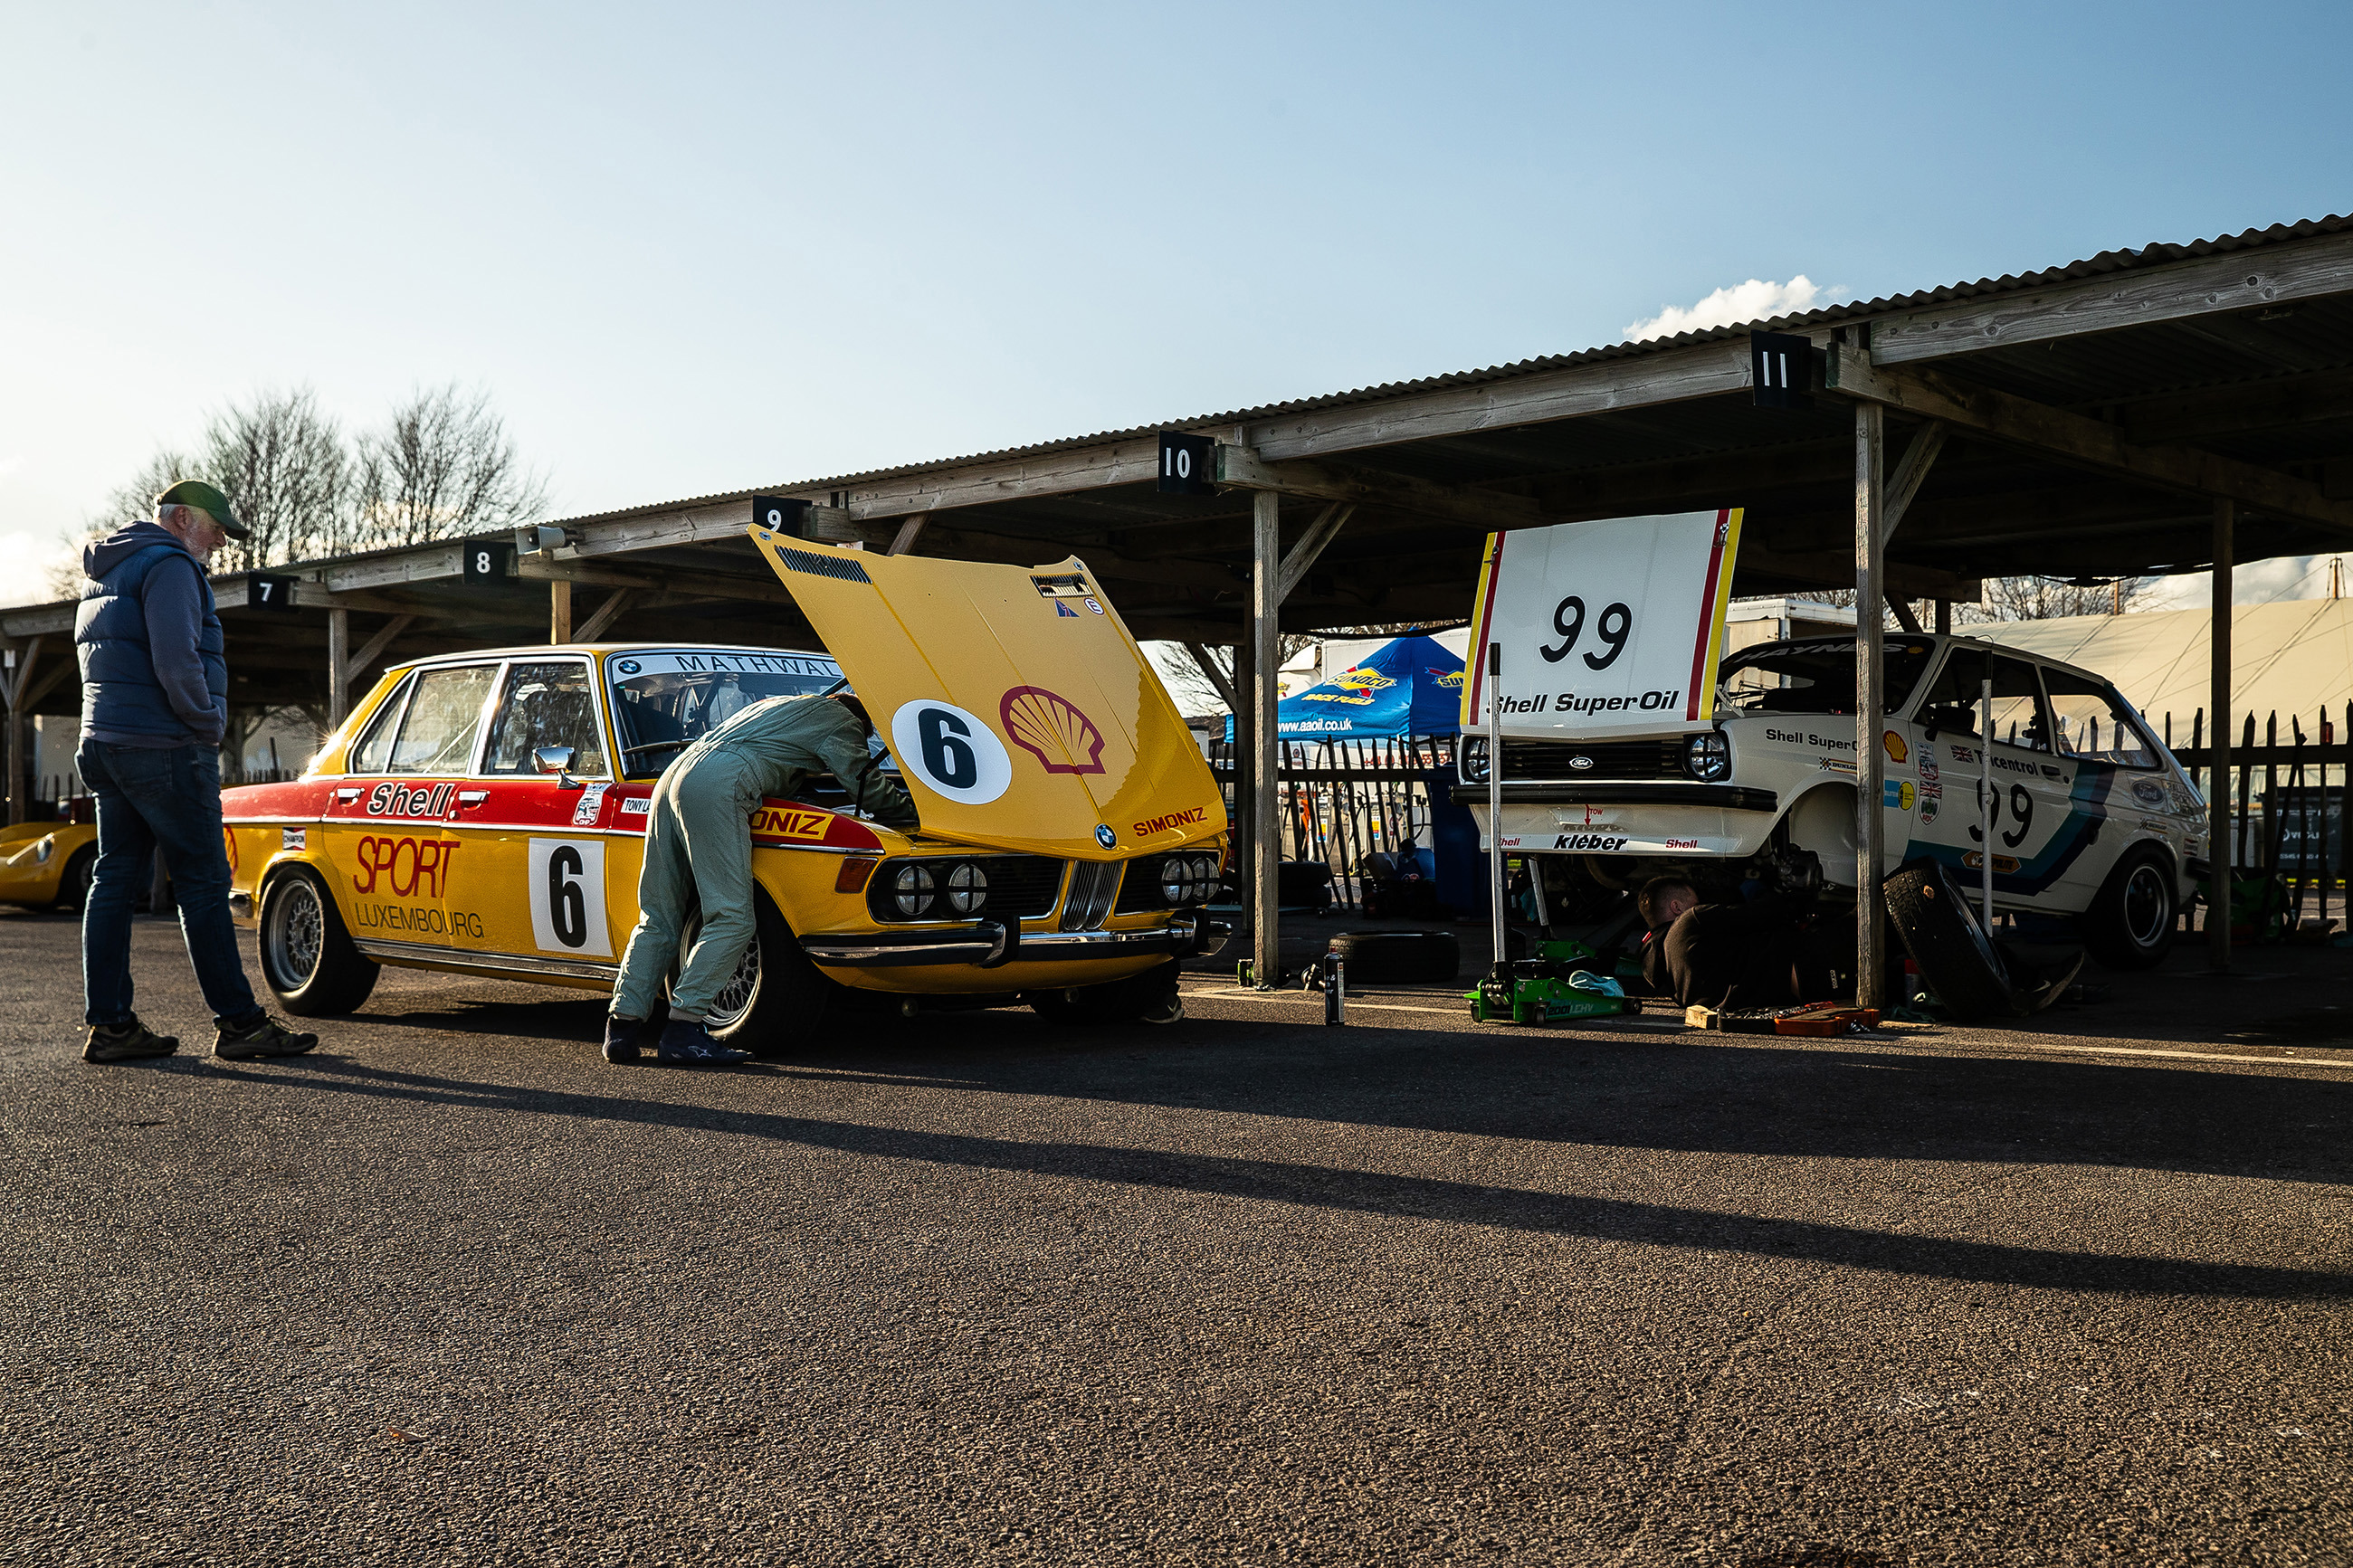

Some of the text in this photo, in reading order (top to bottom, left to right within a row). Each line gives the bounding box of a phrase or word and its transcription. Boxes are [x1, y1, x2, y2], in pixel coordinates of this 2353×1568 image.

[1762, 351, 1787, 388] 11
[1166, 447, 1191, 479] 10
[767, 508, 782, 532] 9
[476, 551, 491, 574] 8
[259, 582, 273, 603] 7
[1539, 595, 1633, 671] 99
[1733, 643, 1907, 664] HAYNS
[674, 655, 843, 678] MATHWAL
[1329, 675, 1392, 688] SUNOCO
[1278, 717, 1352, 733] www.aaoil.co.uk
[1766, 729, 1804, 744] Shell
[918, 708, 977, 789] 6
[1832, 763, 1857, 771] DUNLO
[1974, 749, 2038, 775] Ticentrol
[367, 783, 455, 817] Shell
[624, 800, 650, 813] TONY L
[1967, 777, 2033, 848] 99
[748, 810, 827, 835] ONIZ
[1133, 807, 1208, 837] SIMONIZ
[1498, 837, 1520, 847] hell
[1665, 839, 1698, 849] Shell
[354, 836, 461, 898] SPORT
[549, 845, 587, 948] 6
[356, 903, 484, 938] LUXEMBOURG
